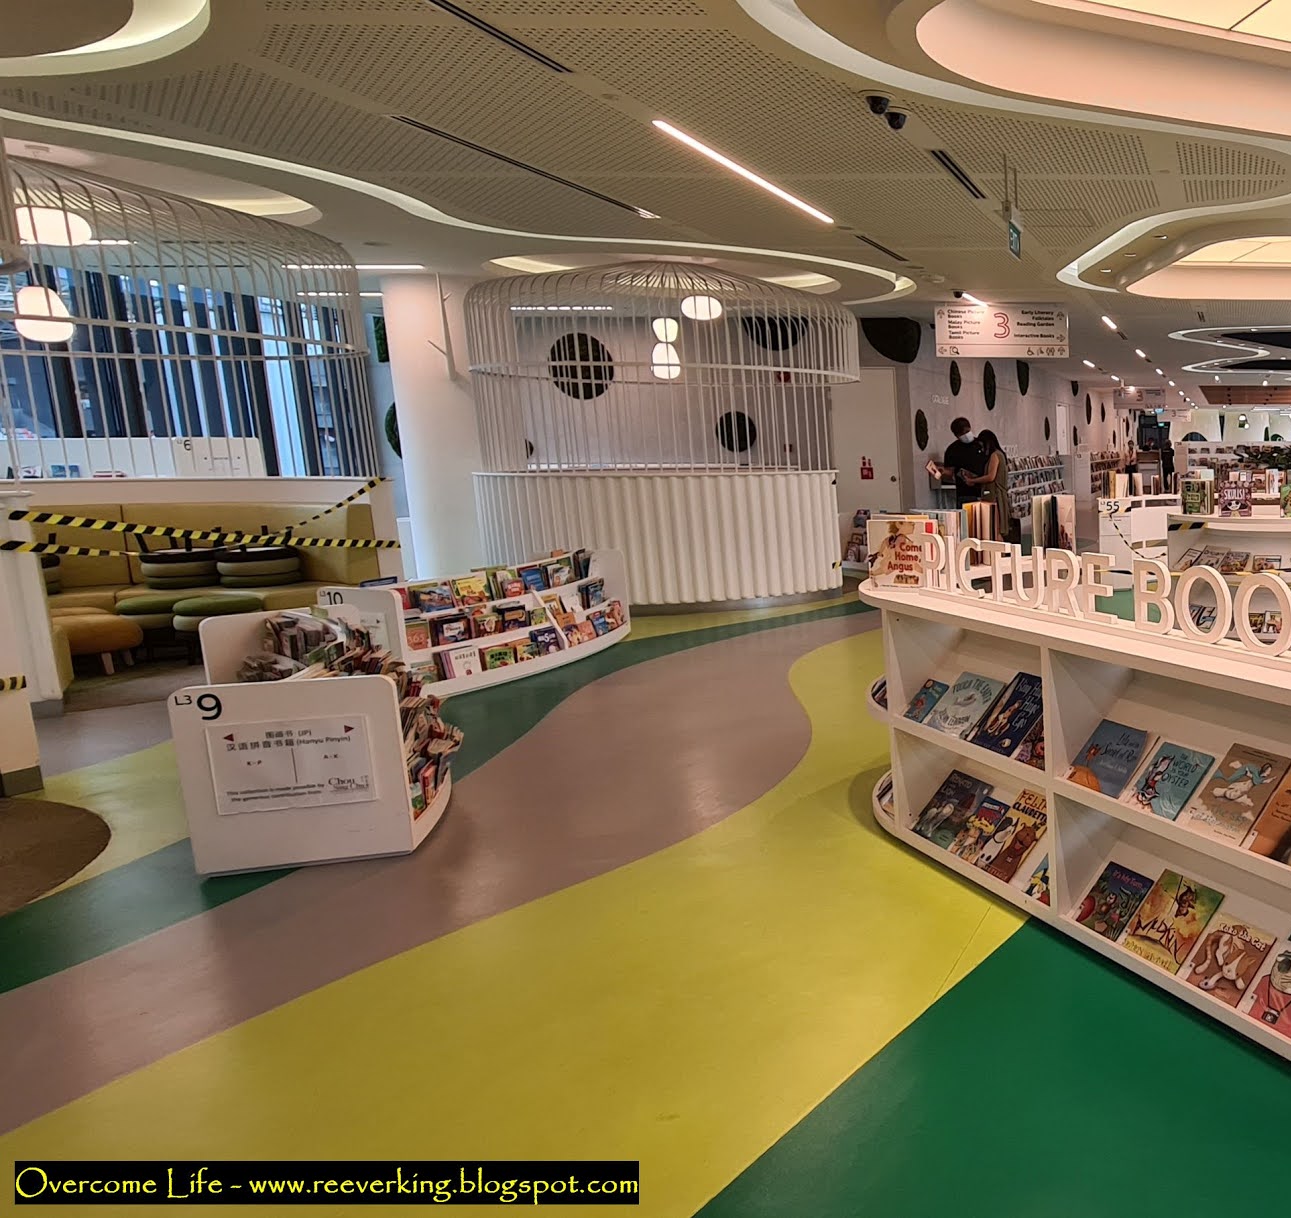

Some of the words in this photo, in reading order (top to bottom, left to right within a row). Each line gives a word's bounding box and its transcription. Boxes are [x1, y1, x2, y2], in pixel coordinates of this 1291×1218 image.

[994, 312, 1010, 339] 3
[184, 439, 191, 451] 6
[1106, 501, 1120, 512] 55
[895, 552, 922, 563] Home,
[887, 561, 913, 573] Angus
[919, 532, 1118, 625] PICTURE
[326, 591, 343, 605] 10
[174, 695, 192, 706] L3
[197, 693, 222, 720] 9
[1172, 760, 1198, 773] WORLD
[1161, 773, 1189, 788] OYSTER
[1251, 937, 1267, 952] Cat
